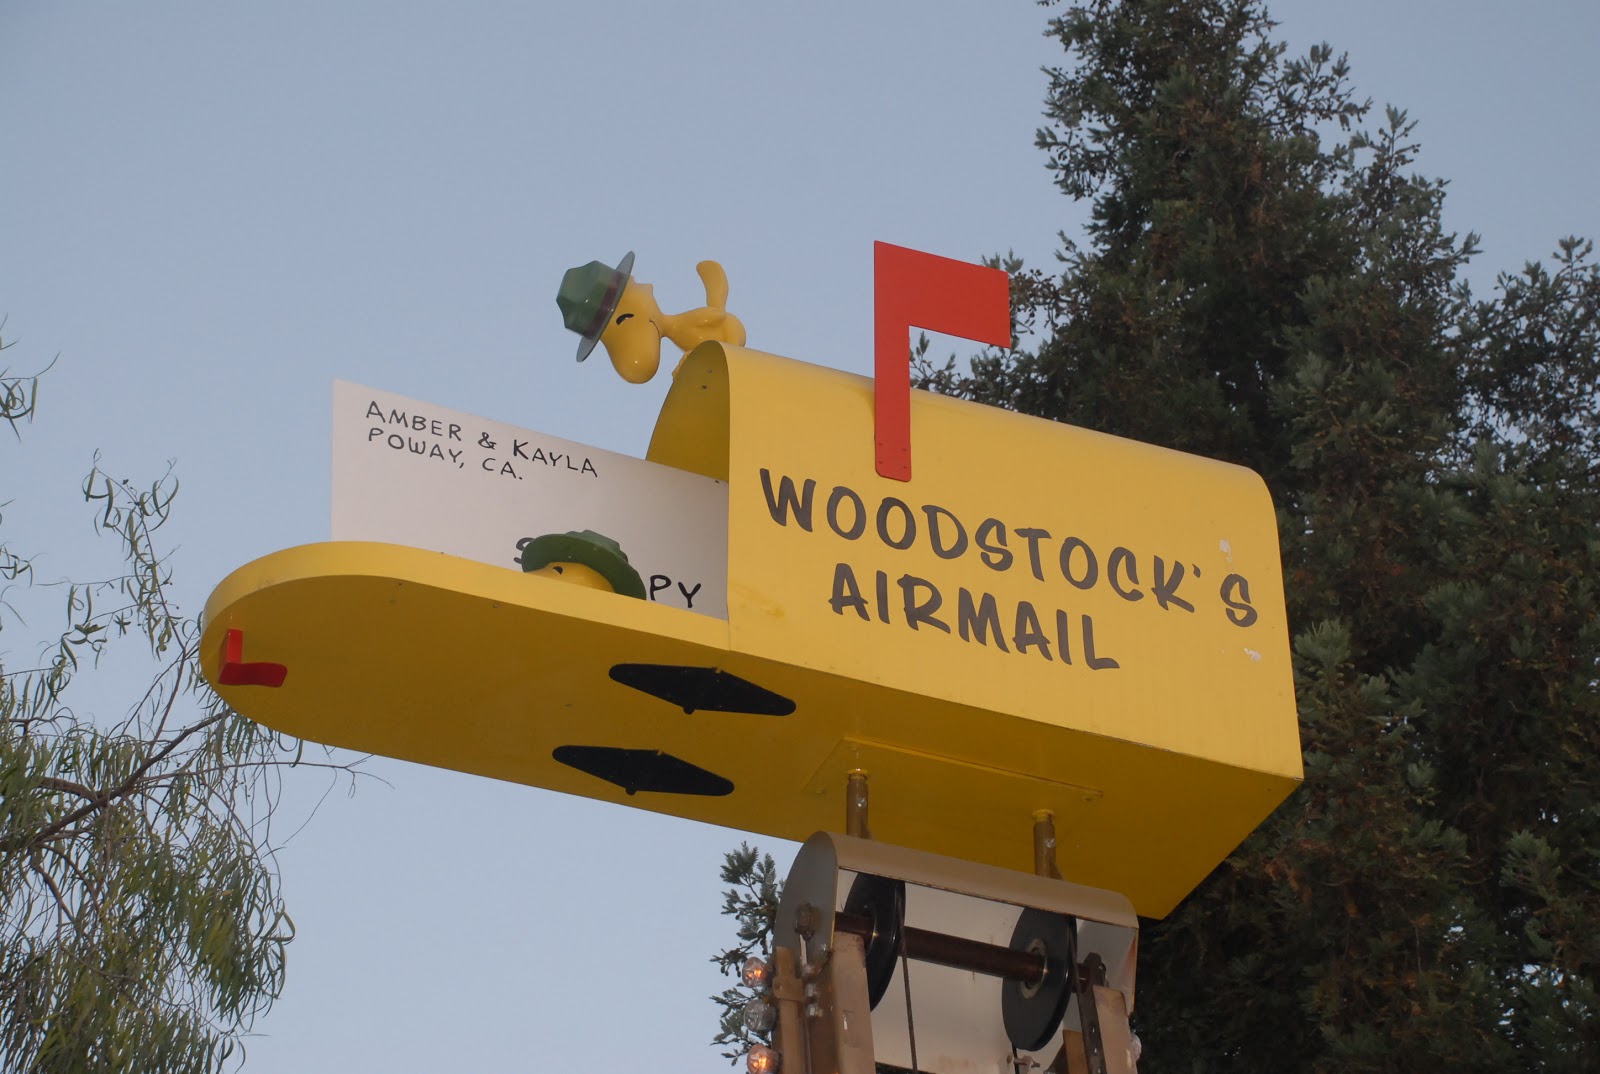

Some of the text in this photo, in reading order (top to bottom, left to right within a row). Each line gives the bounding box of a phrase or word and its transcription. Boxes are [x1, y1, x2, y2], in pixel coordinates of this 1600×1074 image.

[365, 400, 599, 478] AMBER & KAYLA
[368, 427, 524, 480] POWAY, CA.
[759, 467, 1258, 628] WOODSTOCK'S
[828, 562, 1120, 671] AIRMAIL
